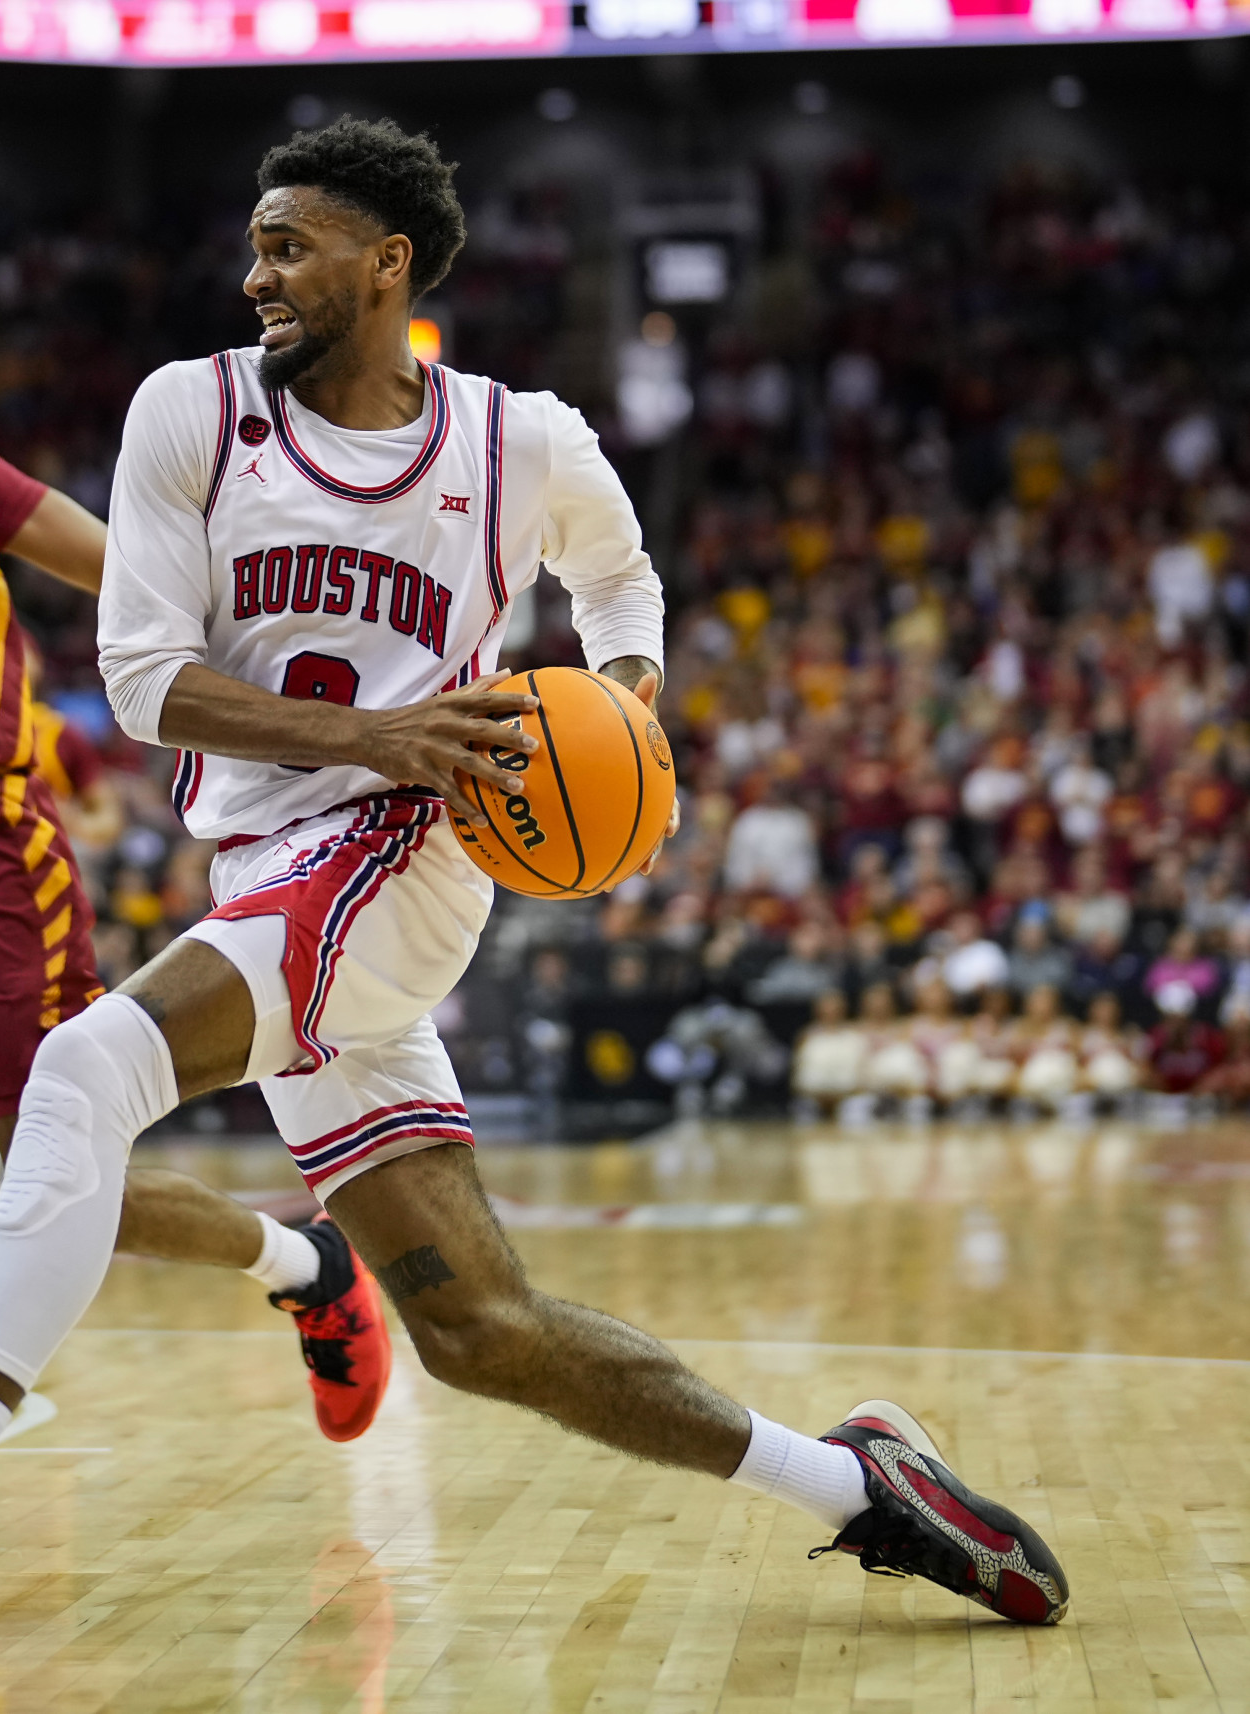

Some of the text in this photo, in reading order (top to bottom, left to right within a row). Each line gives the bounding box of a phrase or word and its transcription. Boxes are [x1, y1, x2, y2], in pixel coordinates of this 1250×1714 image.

[243, 420, 266, 440] 32
[439, 493, 470, 514] XII
[233, 544, 452, 660] HOUSTON
